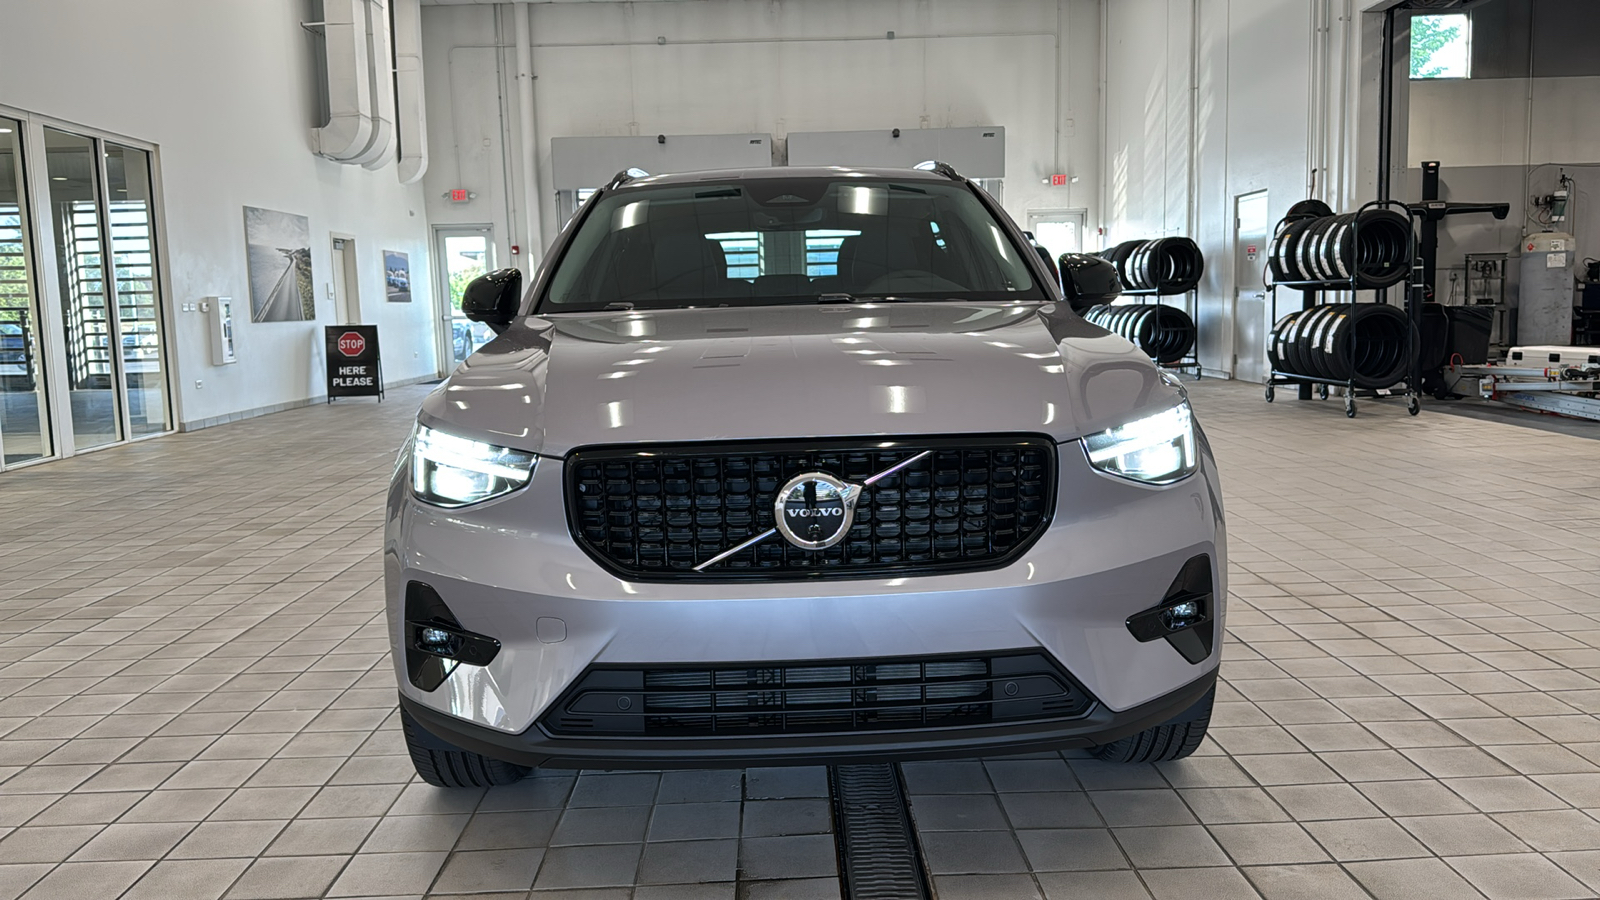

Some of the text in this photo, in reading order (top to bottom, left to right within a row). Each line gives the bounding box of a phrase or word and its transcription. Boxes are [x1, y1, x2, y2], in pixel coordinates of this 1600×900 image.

[1053, 174, 1066, 186] EXIT
[340, 339, 363, 349] STOP
[338, 366, 367, 376] HERE
[332, 376, 374, 387] PLEASE
[786, 507, 843, 518] VOLVO
